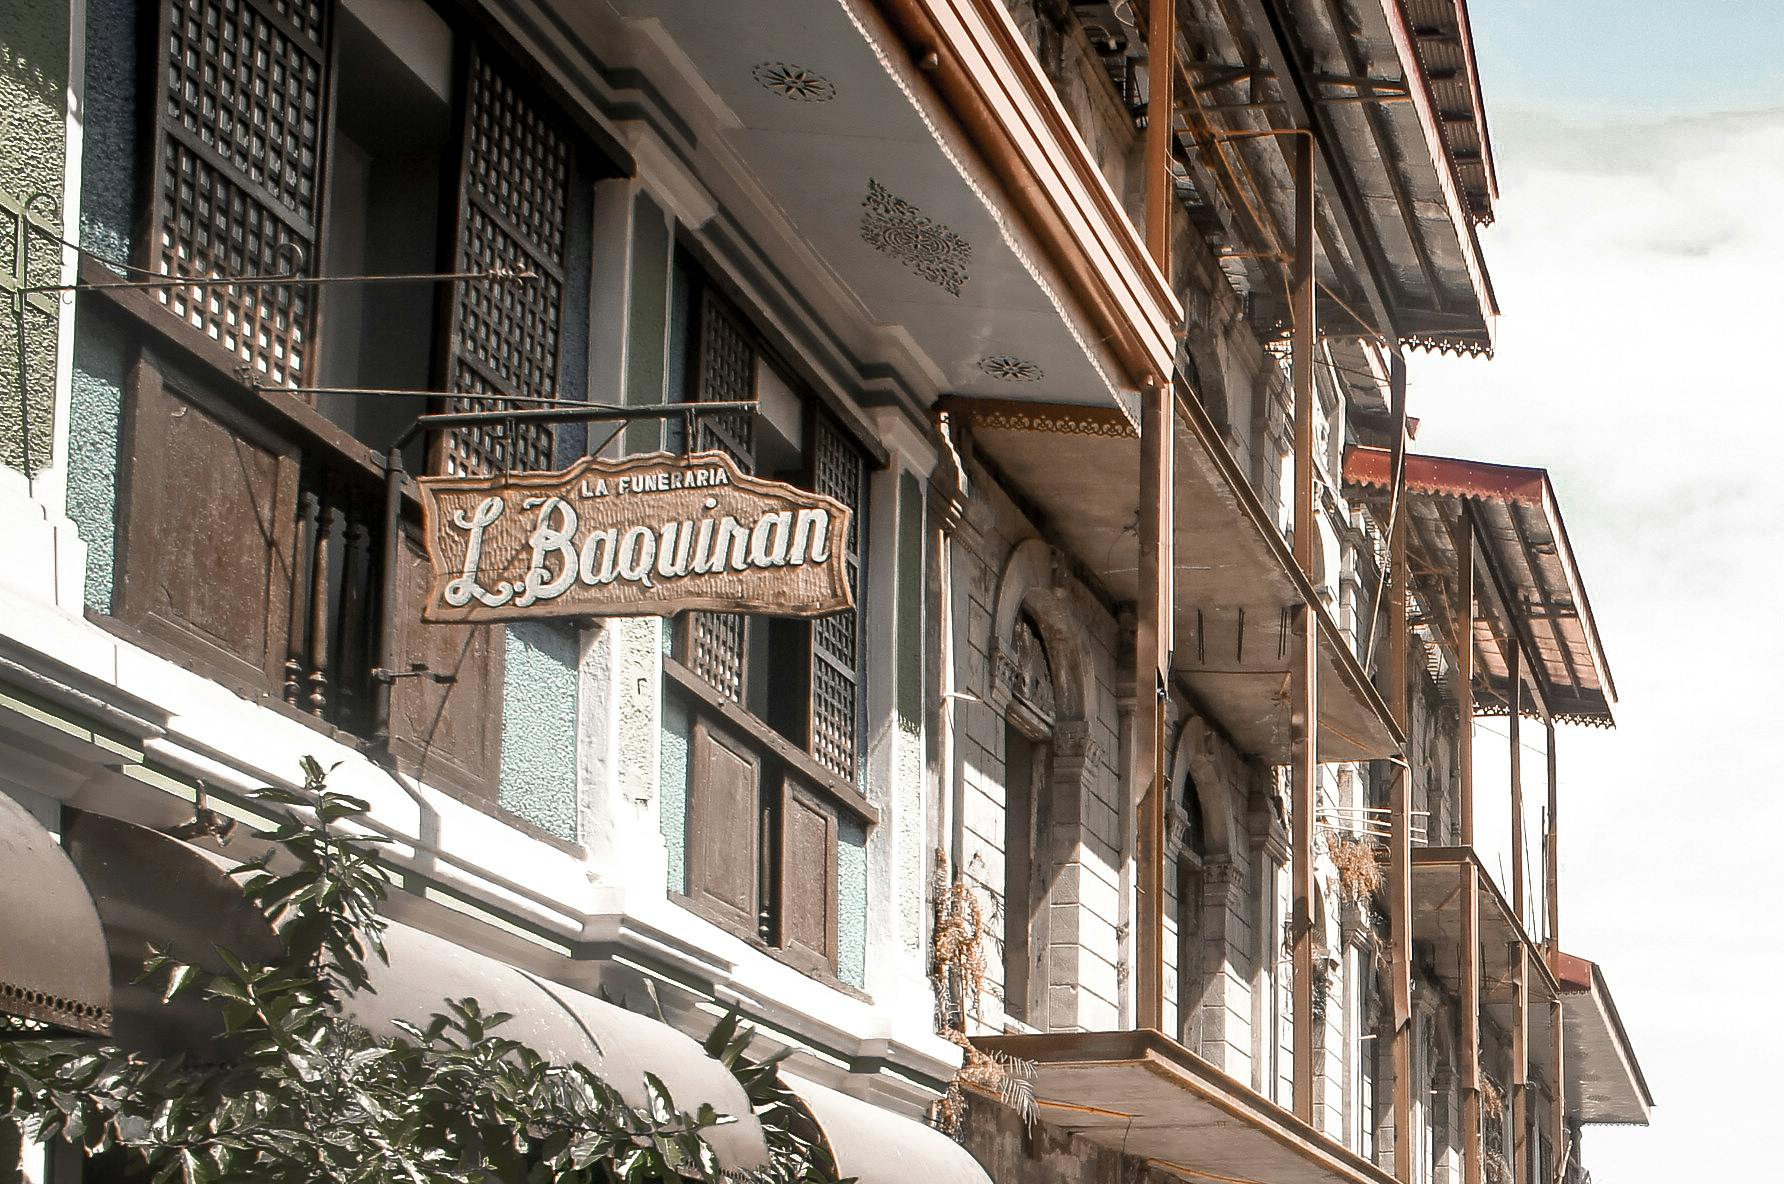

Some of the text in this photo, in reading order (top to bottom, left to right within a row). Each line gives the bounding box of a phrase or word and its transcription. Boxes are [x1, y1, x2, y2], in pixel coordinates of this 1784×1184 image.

[581, 467, 729, 498] LA FUNERARIA
[515, 496, 831, 607] Baquiran
